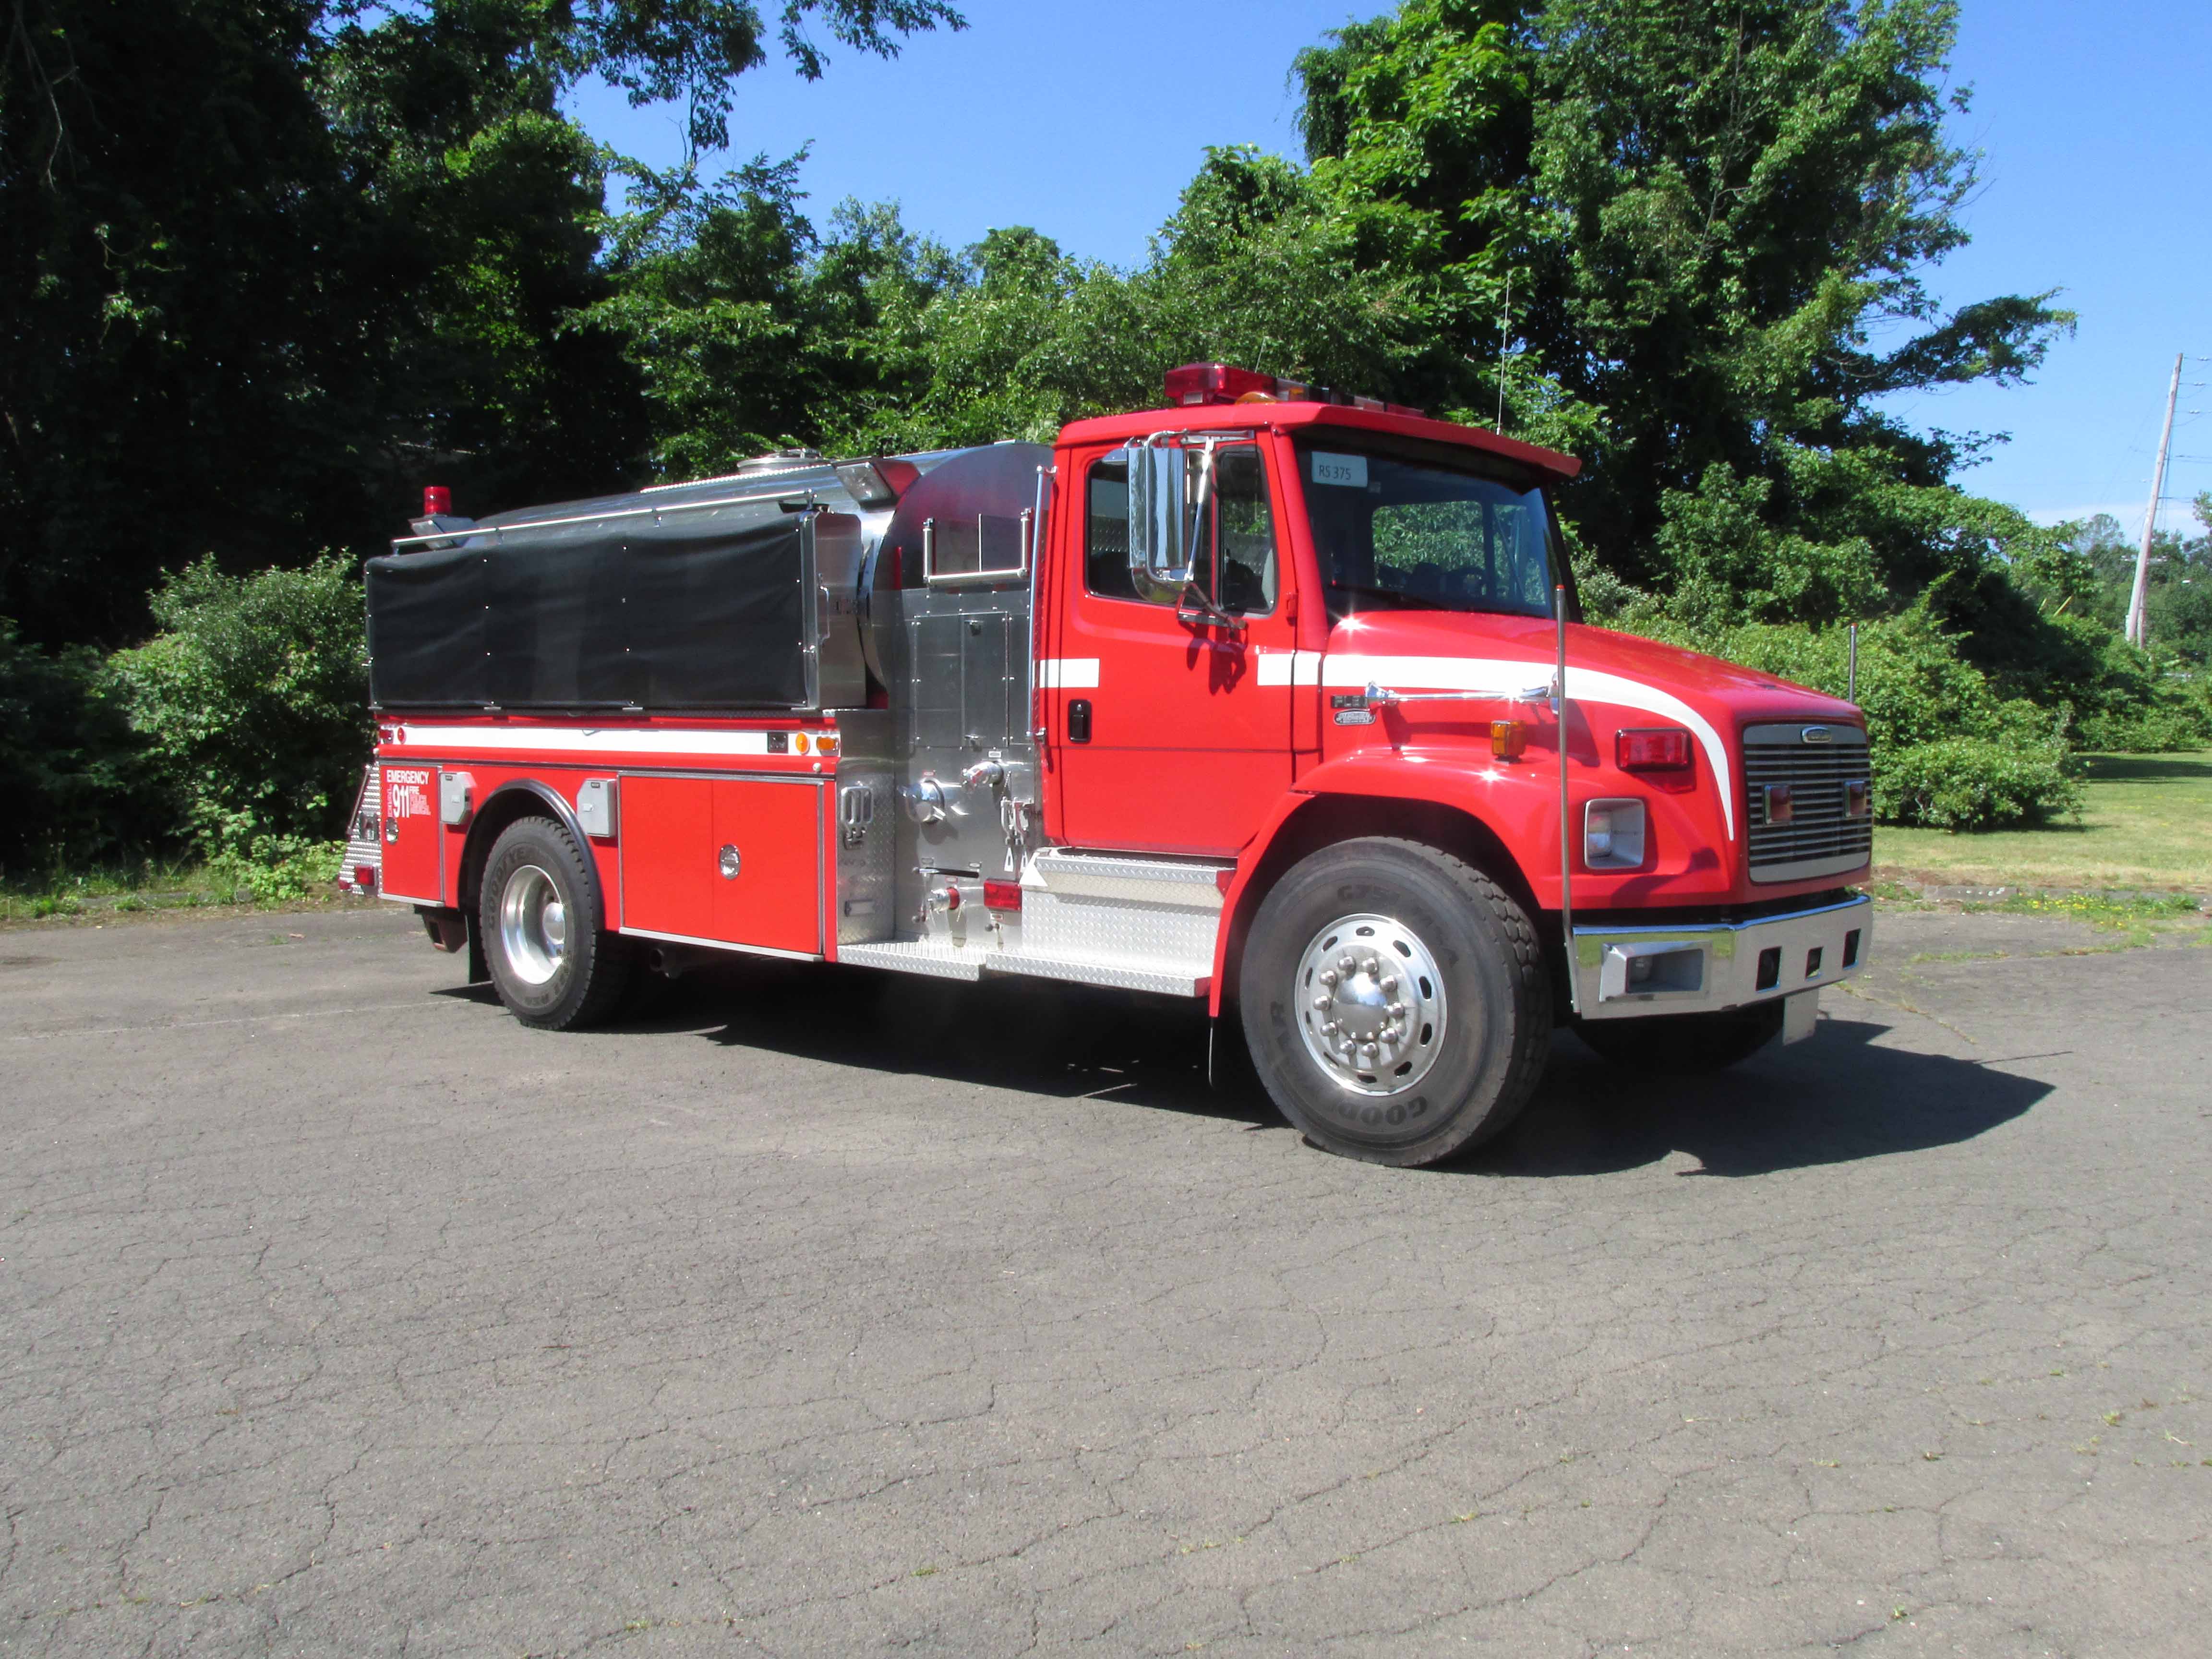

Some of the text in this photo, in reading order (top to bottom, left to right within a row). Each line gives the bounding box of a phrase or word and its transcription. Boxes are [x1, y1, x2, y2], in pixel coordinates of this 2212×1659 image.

[1319, 464, 1351, 481] RS 375
[386, 770, 429, 784] EMERGENCY
[409, 786, 420, 795] FIRE
[393, 784, 409, 818] 911
